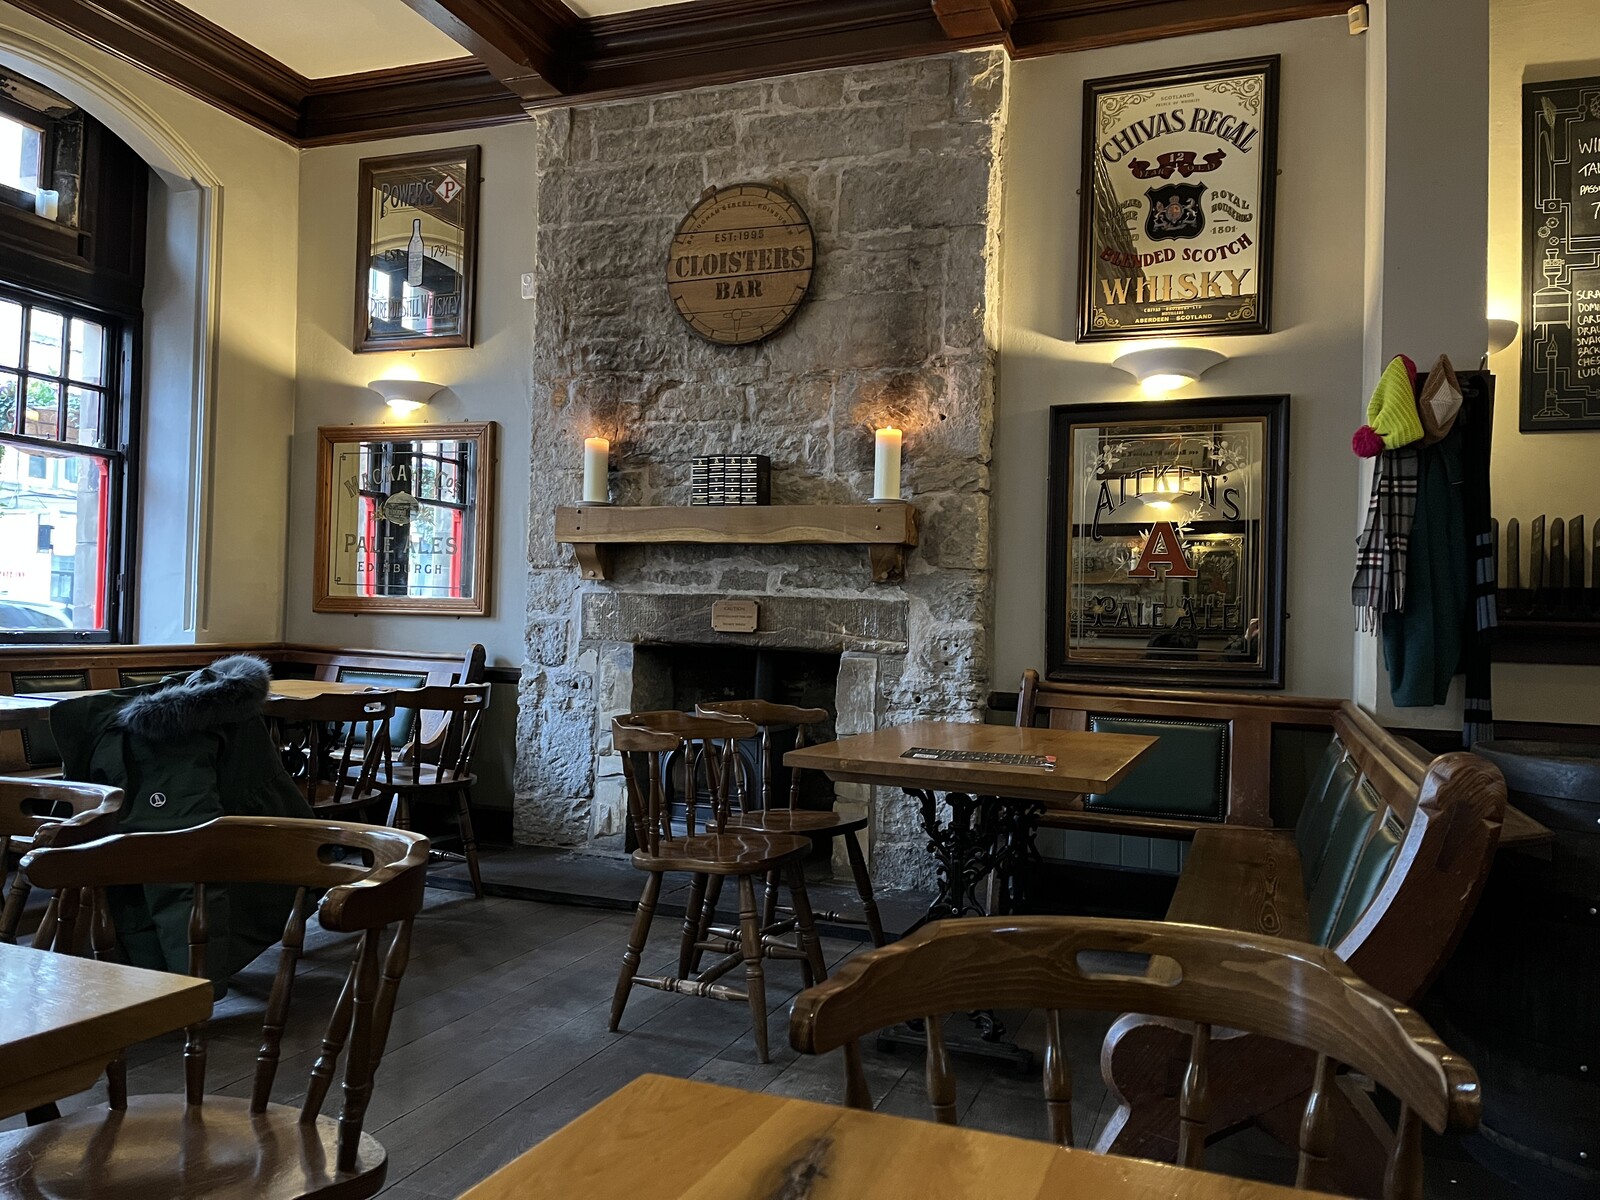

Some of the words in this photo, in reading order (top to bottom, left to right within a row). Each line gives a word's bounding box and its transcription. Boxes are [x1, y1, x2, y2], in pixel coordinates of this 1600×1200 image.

[1102, 109, 1186, 163] CHIVAS
[1188, 107, 1259, 153] REGAL
[1139, 167, 1164, 177] YEAR
[1187, 163, 1216, 171] OLD
[1170, 152, 1185, 163] 12
[380, 178, 435, 219] POWER'S
[444, 181, 456, 199] P
[1211, 190, 1250, 210] ROYAL
[675, 245, 805, 278] CLOISTERS
[1100, 247, 1176, 270] BLENDED
[1182, 232, 1253, 263] SCOTCH
[715, 280, 763, 300] BAR
[1101, 268, 1251, 305] WHISKY
[421, 294, 461, 319] WHISKEY
[1135, 316, 1170, 324] ABERDEEN
[1176, 313, 1213, 321] SCOTLAND
[1091, 465, 1240, 542] AITKEN'S
[344, 533, 395, 553] PALE
[403, 536, 458, 555] ALES
[1127, 520, 1199, 578] A
[1091, 596, 1167, 629] PALE
[1170, 597, 1239, 630] ALE
